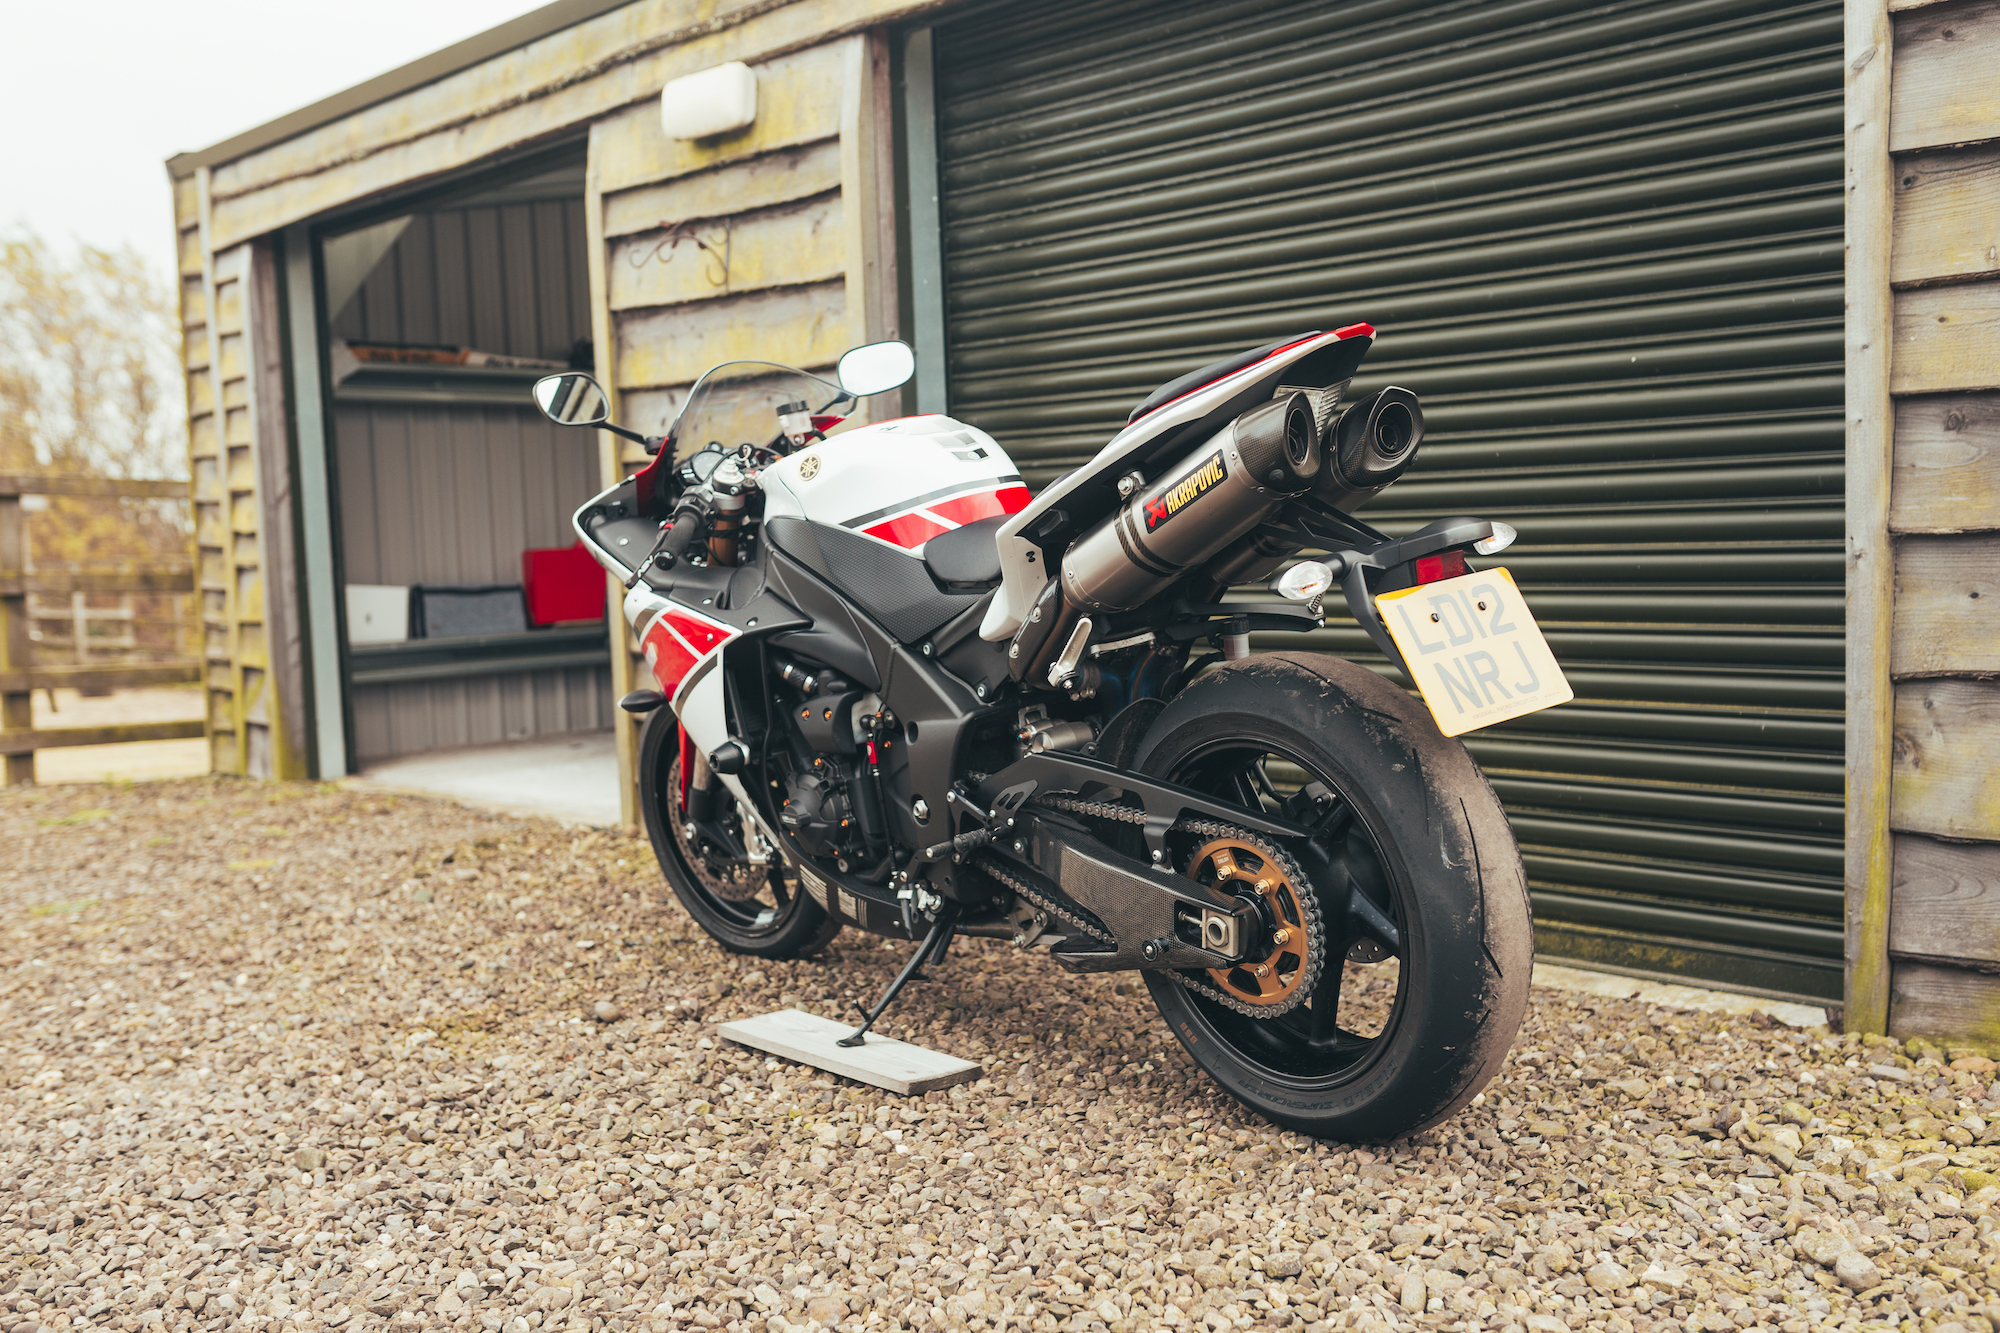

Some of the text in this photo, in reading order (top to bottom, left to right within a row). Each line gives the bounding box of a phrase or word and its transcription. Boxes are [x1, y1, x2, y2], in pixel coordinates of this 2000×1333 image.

[1396, 583, 1517, 656] LD12
[1433, 640, 1541, 715] NRJ
[1472, 709, 1497, 719] KNOCKHILL
[1496, 703, 1513, 712] RACING
[1512, 698, 1529, 707] CIRCUIT
[1528, 695, 1538, 703] LTD
[1343, 1058, 1399, 1109] DIABLO
